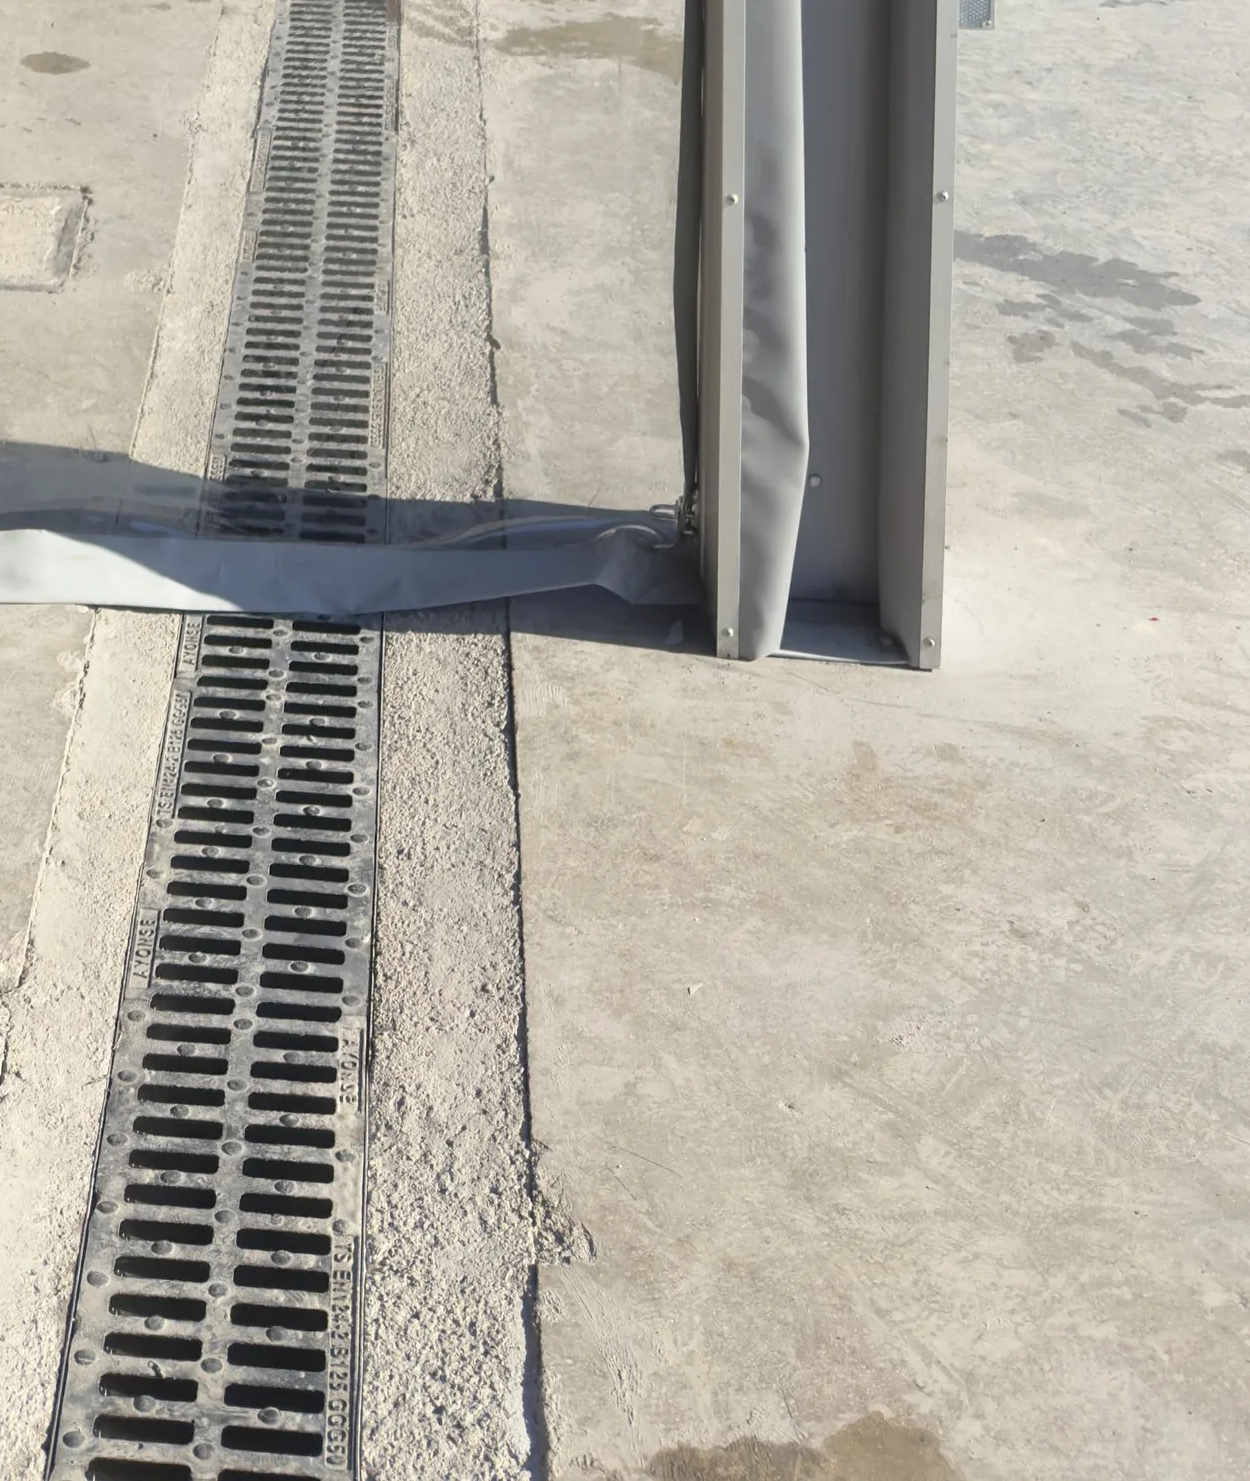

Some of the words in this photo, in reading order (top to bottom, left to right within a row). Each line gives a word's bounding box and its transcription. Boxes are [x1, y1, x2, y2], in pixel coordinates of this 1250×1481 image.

[133, 919, 155, 979] AYONSE
[334, 1242, 353, 1263] TS
[329, 1348, 349, 1391] B125
[326, 1398, 347, 1466] GGG50
